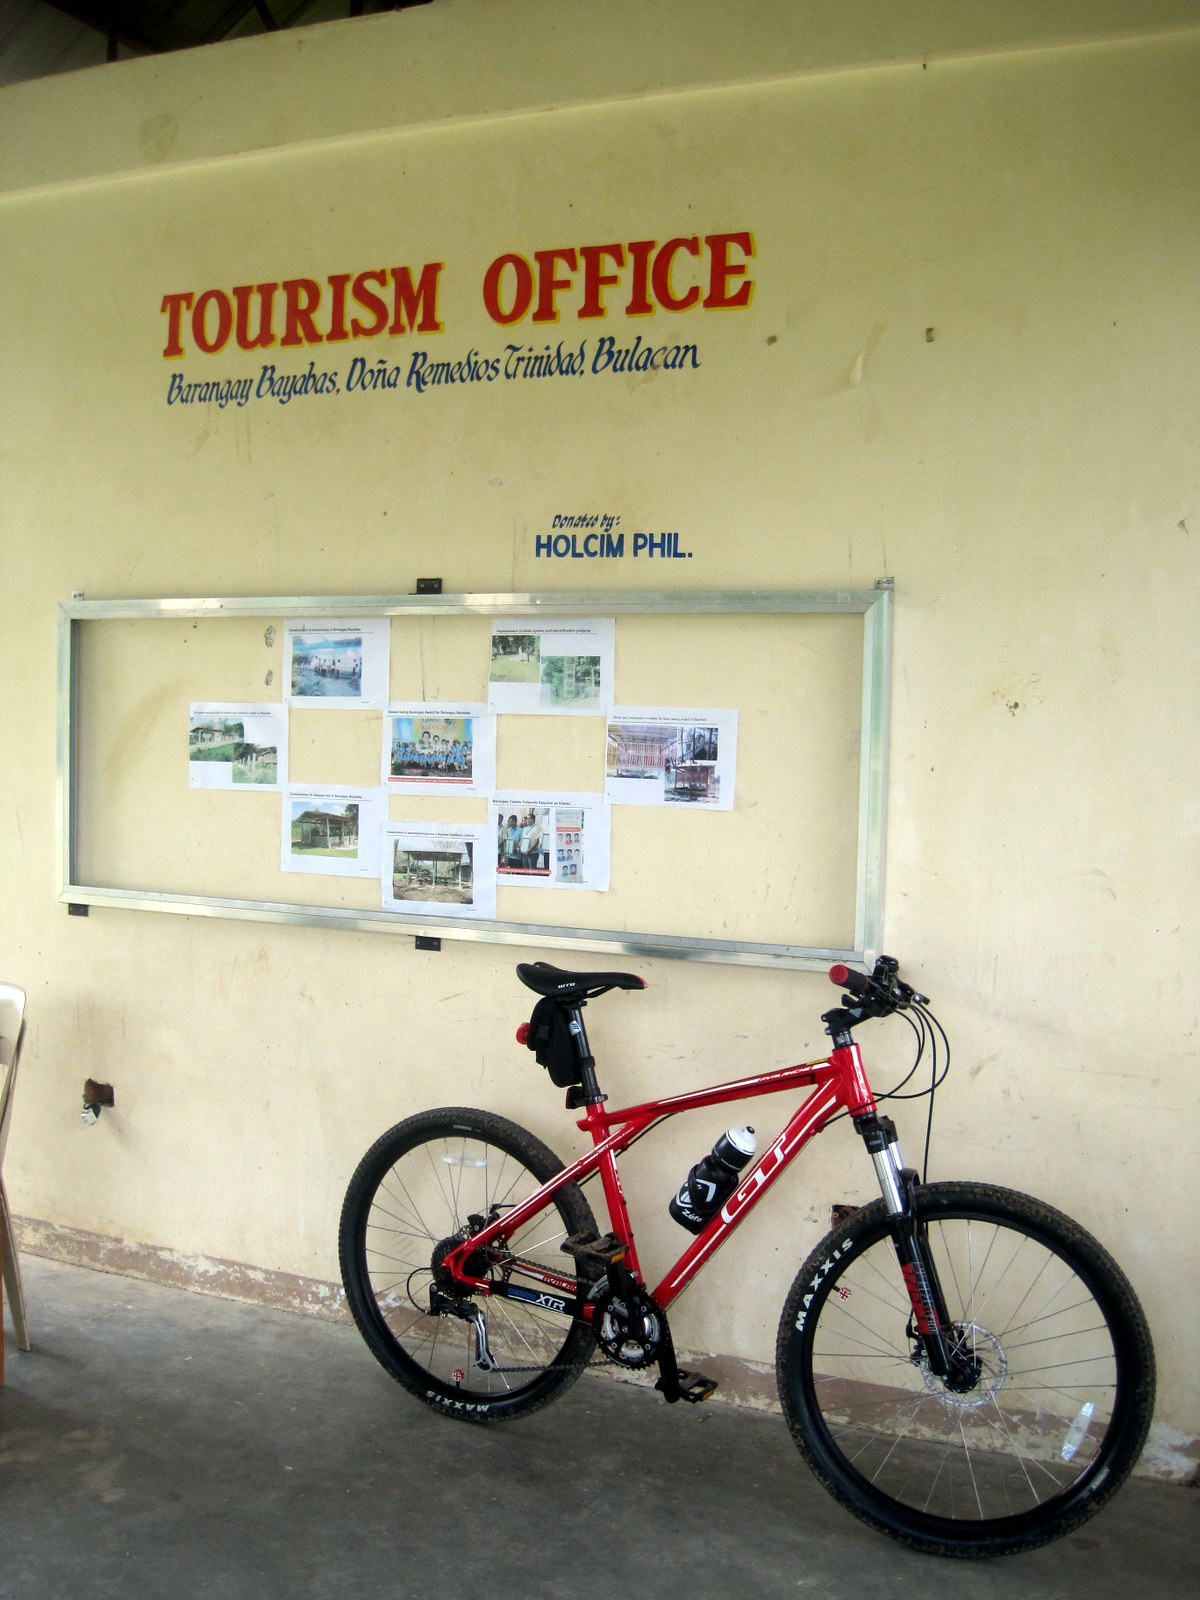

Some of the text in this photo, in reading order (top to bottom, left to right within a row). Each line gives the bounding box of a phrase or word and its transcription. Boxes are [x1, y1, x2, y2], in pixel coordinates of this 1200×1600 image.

[161, 232, 755, 358] TOURISM OFFICE
[167, 336, 702, 409] Barangay Bayabas, Doña Remedios Trinidad, Bulacan
[552, 513, 621, 533] Donated by:
[535, 532, 693, 558] HOLCIM PHIL.
[795, 1238, 853, 1332] MAXXIS
[535, 1292, 566, 1311] XTR
[426, 1389, 490, 1413] MAXXIS
